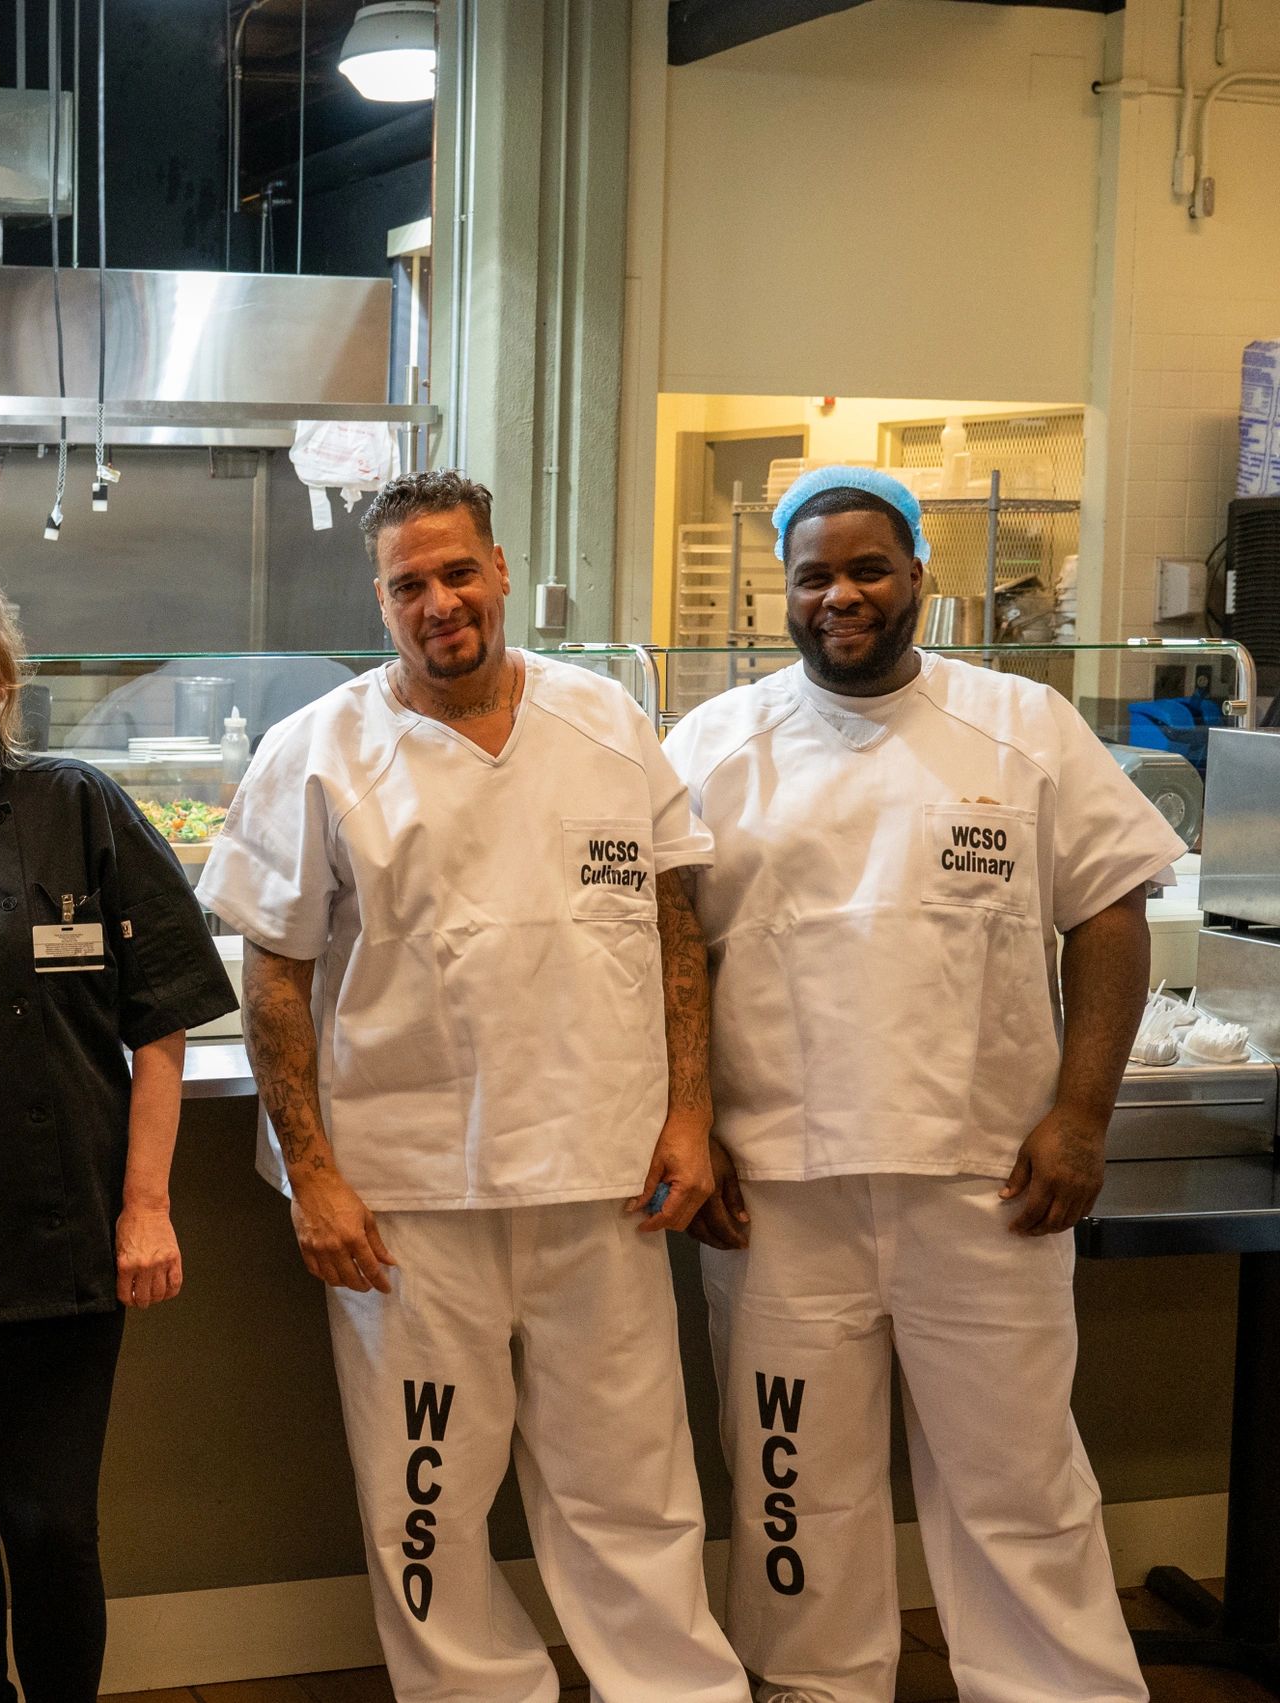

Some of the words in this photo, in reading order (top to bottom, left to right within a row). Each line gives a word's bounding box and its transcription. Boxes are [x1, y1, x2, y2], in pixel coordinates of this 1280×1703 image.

[589, 840, 639, 862] WCSO
[951, 826, 1007, 851] WCSO
[580, 864, 648, 892] Culinary
[941, 849, 1015, 883] Culinary
[755, 1371, 806, 1596] WCSO
[401, 1379, 456, 1622] WCSO
